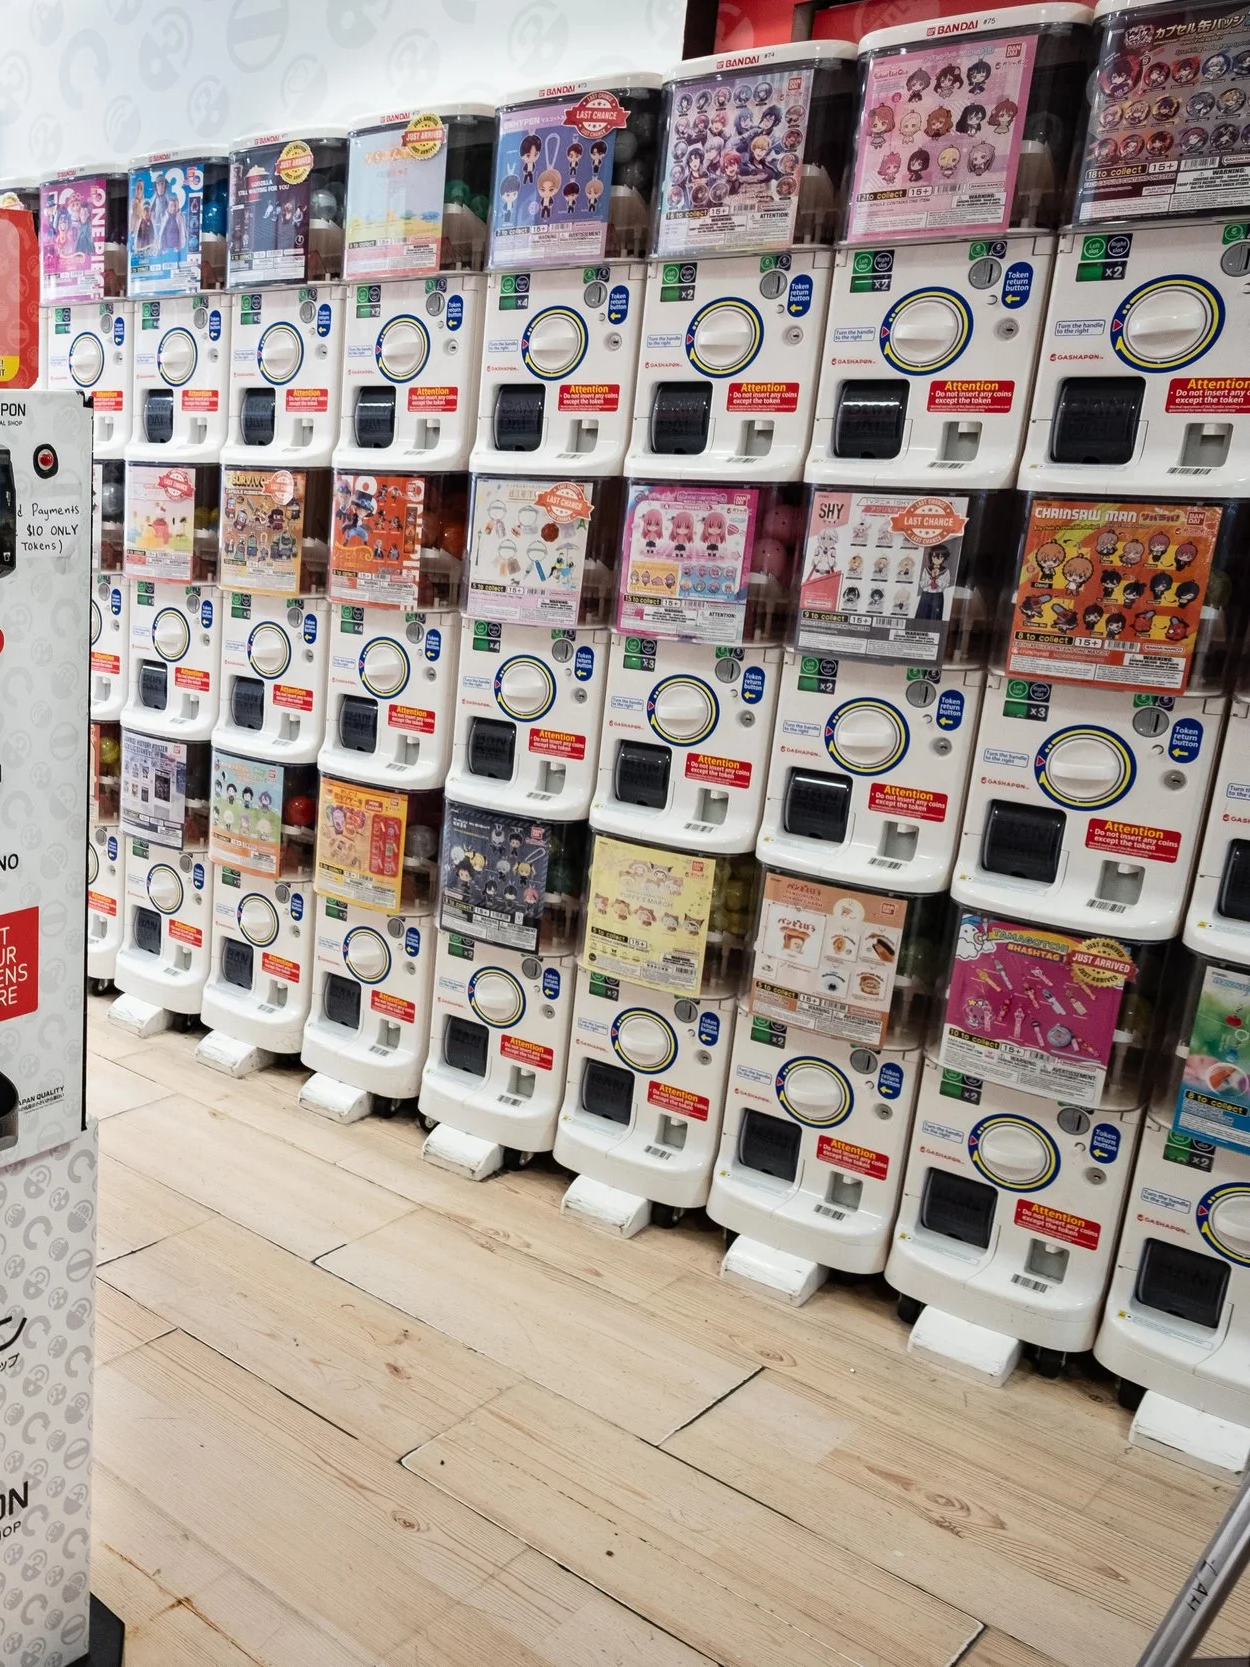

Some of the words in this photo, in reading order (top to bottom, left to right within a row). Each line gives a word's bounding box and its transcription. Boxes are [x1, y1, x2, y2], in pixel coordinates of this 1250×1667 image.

[938, 20, 978, 35] BANDAI
[726, 56, 759, 68] BANDAI
[576, 111, 592, 120] LAST
[593, 110, 617, 120] CHANCE
[406, 132, 420, 141] JUST
[422, 131, 443, 140] ARRIVED
[1213, 168, 1246, 176] WARNING:
[1008, 271, 1029, 279] Token
[1105, 266, 1123, 278] x2
[1005, 284, 1029, 292] button
[740, 383, 786, 392] Attention
[945, 381, 999, 392] Attention
[32, 502, 79, 521] Payments
[819, 503, 844, 519] SHY
[1035, 507, 1100, 520] CHAINSAW
[1106, 512, 1136, 522] MAN
[904, 517, 921, 525] LAST
[924, 517, 953, 526] CHANCE
[27, 525, 44, 537] $10
[50, 524, 79, 536] ONLY
[1040, 634, 1068, 644] collect
[883, 785, 933, 801] Attention
[1105, 821, 1164, 839] Attention
[992, 928, 1070, 952] TAMAGOTCHI
[1007, 943, 1060, 962] #HASHTAG
[1072, 953, 1093, 964] JUST
[1094, 956, 1131, 973] ARRIVED
[509, 1037, 544, 1053] Attention
[37, 1085, 64, 1100] QUALITY
[831, 1139, 877, 1159] Attention
[1031, 1203, 1086, 1228] Attention
